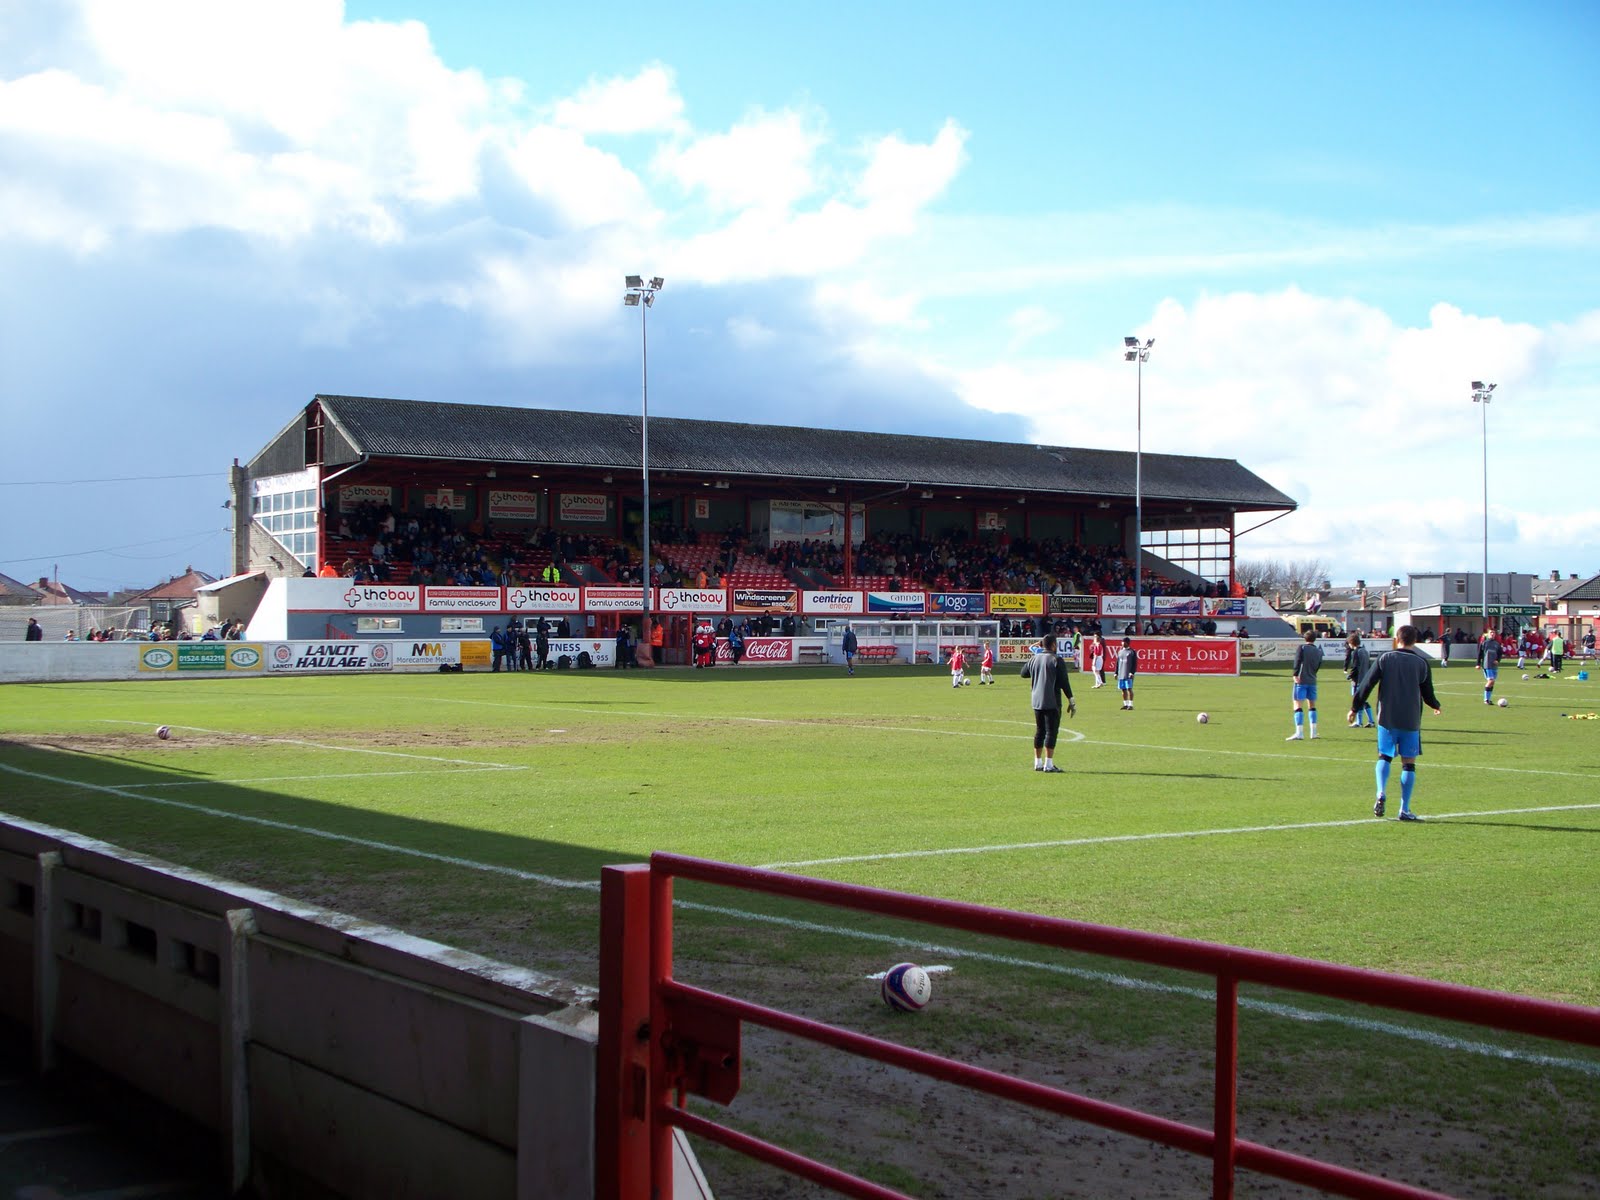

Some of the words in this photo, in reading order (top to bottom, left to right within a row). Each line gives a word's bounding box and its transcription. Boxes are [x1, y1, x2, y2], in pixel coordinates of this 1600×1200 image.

[440, 495, 451, 506] A
[502, 492, 536, 503] thebay
[573, 495, 605, 505] thebay
[699, 505, 706, 515] B
[364, 589, 415, 603] thebay
[529, 590, 576, 603] thebay
[680, 592, 723, 604] thebay
[812, 594, 854, 603] centrica
[890, 594, 923, 602] cannon
[998, 595, 1018, 607] LORD
[429, 599, 455, 607] family
[588, 599, 613, 607] family
[829, 602, 853, 611] energy
[944, 595, 968, 611] logo
[1106, 603, 1124, 612] Ashton
[1500, 606, 1523, 615] LODGE
[305, 645, 359, 656] LANCIT
[746, 641, 791, 659] Coca-Cola
[1106, 645, 1168, 660] WGHT
[1171, 651, 1181, 660] &
[1187, 646, 1229, 661] LORD
[295, 657, 368, 668] HAULAGE
